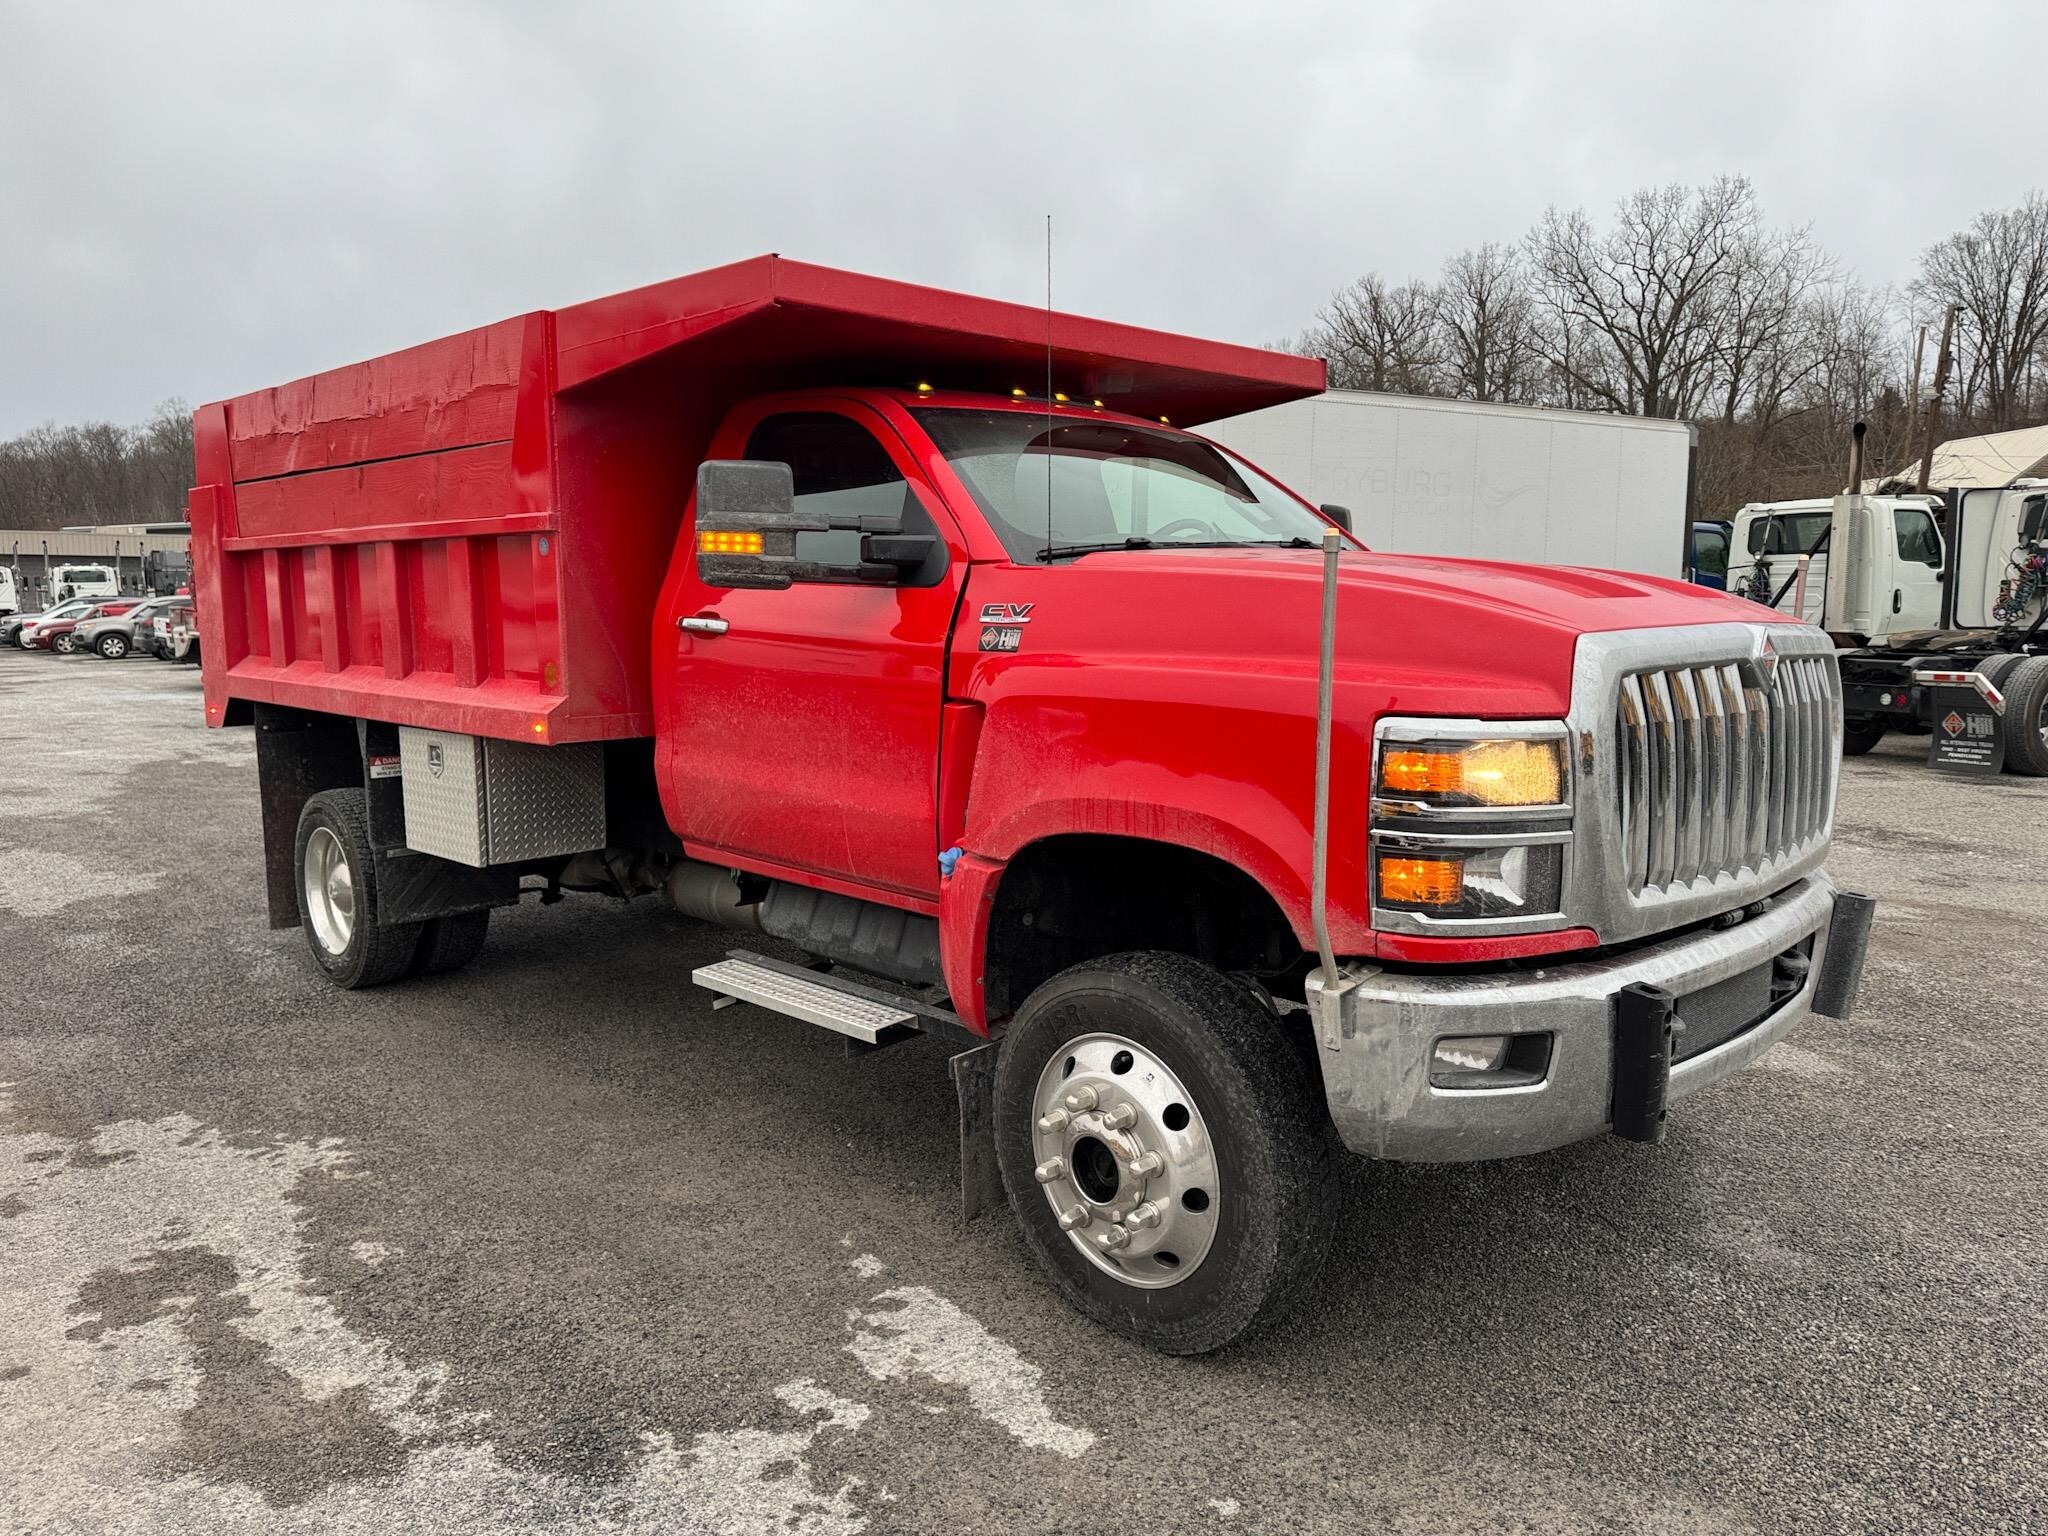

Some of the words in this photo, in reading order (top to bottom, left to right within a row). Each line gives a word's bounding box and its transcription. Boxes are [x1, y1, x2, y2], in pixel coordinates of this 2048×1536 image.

[1314, 464, 1451, 497] FRYBURG
[981, 603, 1034, 617] CV
[998, 631, 1021, 647] Hill
